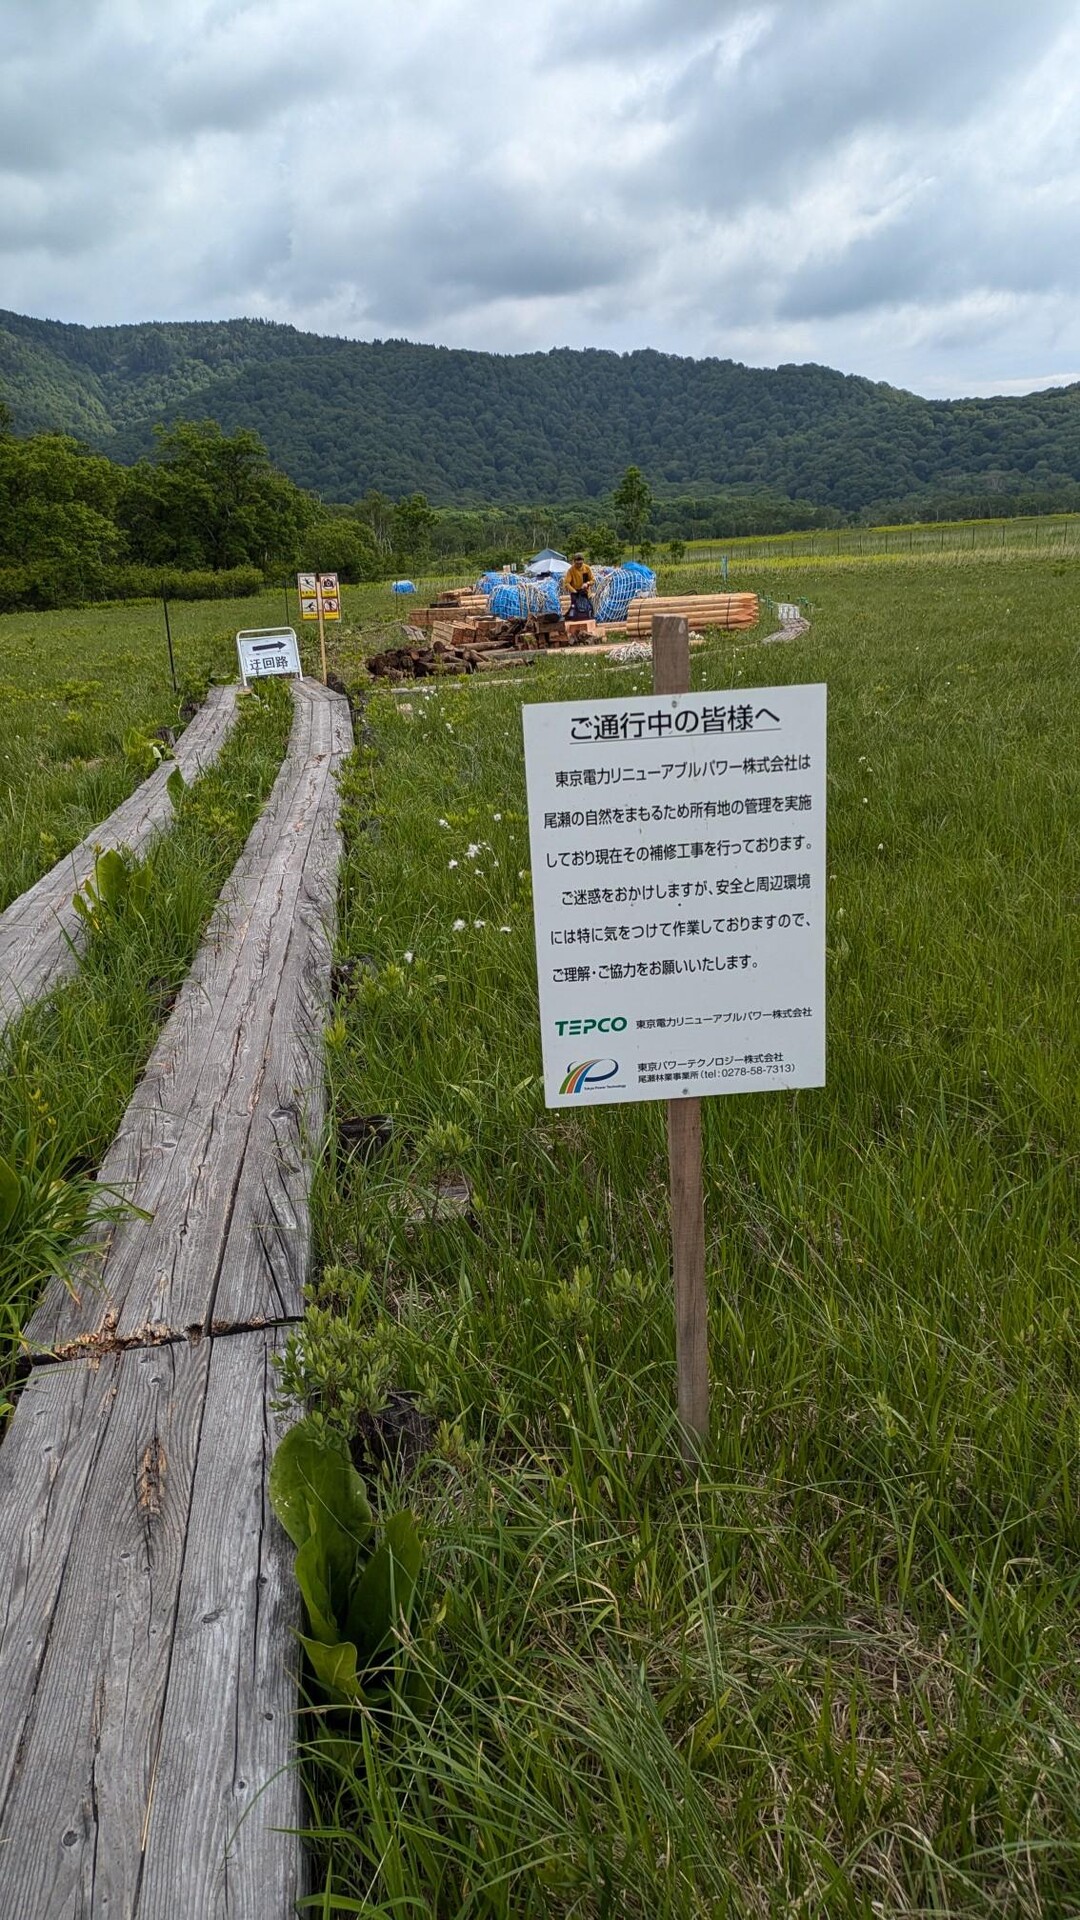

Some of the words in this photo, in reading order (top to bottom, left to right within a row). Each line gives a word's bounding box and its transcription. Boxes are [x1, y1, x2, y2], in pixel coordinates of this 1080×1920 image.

[570, 704, 781, 741] ご通行中の皆様へ
[555, 754, 811, 788] 東京電力リニューアブルパワー株式会社は
[543, 794, 812, 829] 尾瀬の自然をまもるため所有地の管理を実施
[546, 834, 812, 868] しており現在その補修工事を行っております。
[561, 873, 811, 906] ご迷惑をおかけしますが、安全と周辺環境
[550, 912, 811, 945] には特に気をつけて作業しておりますので、
[552, 954, 758, 983] ご理解・ご協力をお願いいたします。
[555, 1016, 627, 1036] TEPCO
[636, 1006, 812, 1030] 東京電力リニューアブルパワー株式会社
[637, 1052, 783, 1072] 東京パワーテクノロジー株式会社
